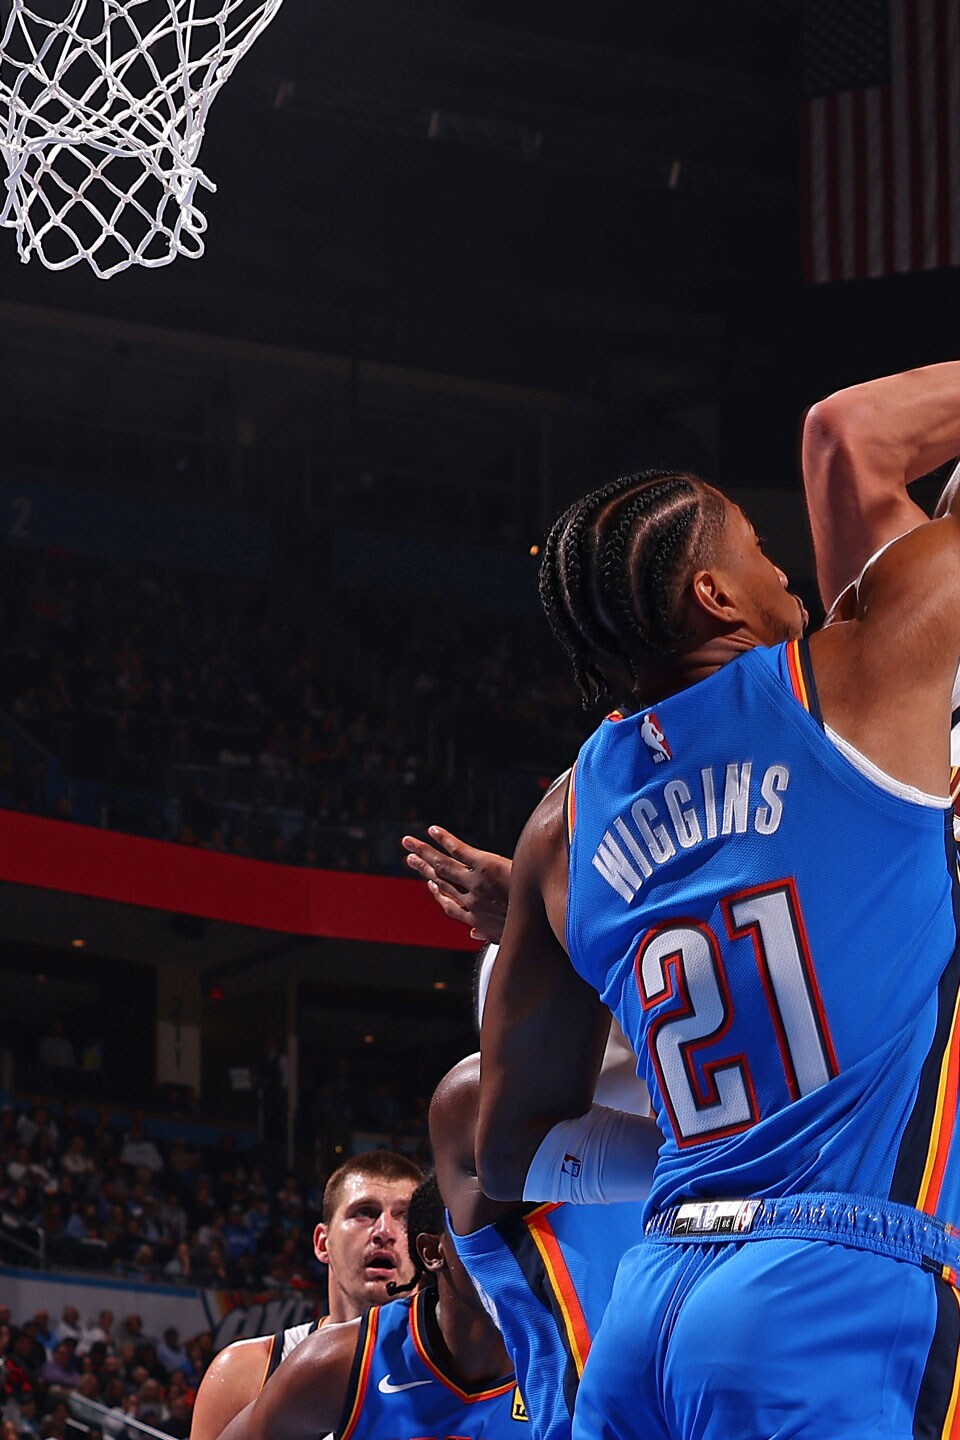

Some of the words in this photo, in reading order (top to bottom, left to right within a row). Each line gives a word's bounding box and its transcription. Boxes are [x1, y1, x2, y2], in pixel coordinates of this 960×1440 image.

[653, 751, 666, 764] NBA
[591, 762, 790, 904] WIGGINS
[634, 875, 841, 1150] 21
